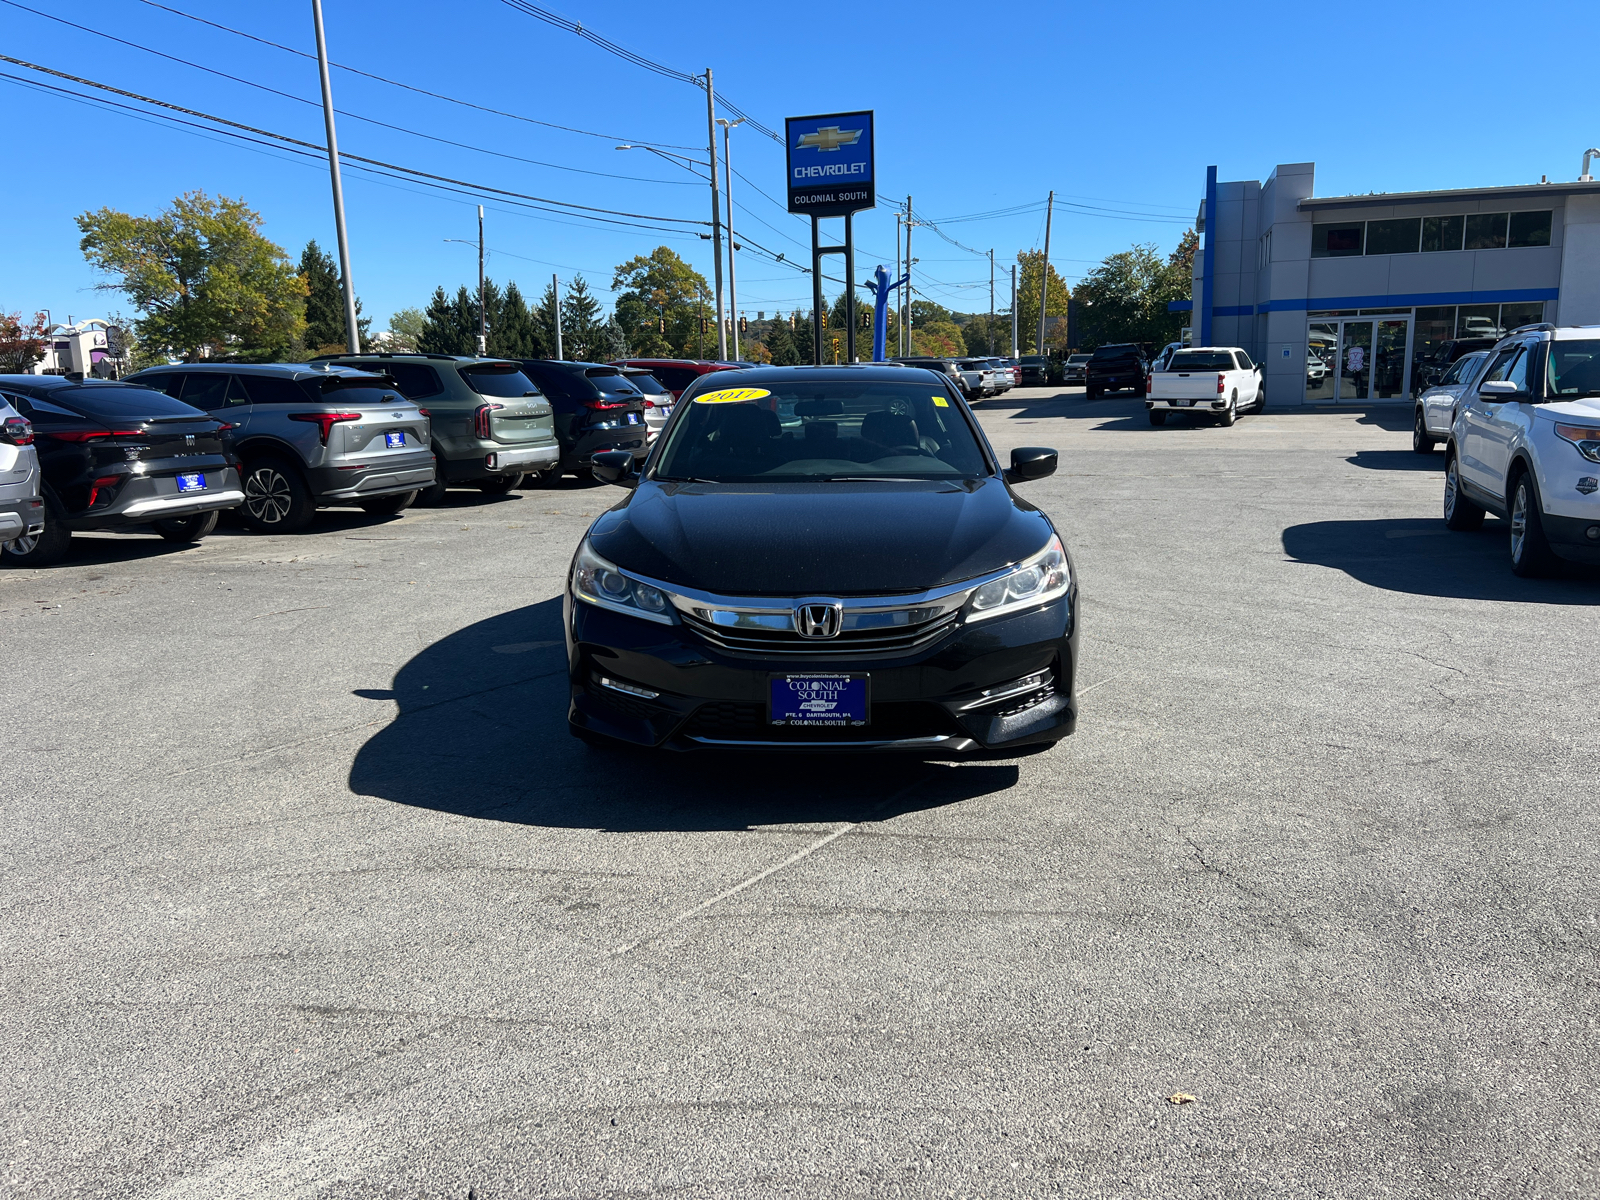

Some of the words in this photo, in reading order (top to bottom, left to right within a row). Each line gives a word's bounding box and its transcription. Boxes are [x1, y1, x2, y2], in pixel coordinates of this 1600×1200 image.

[794, 162, 866, 178] CHEVROLET
[794, 193, 836, 204] COLONIAL
[838, 191, 868, 201] SOUTH
[706, 390, 758, 402] 2017
[789, 681, 847, 691] COLONIAL
[798, 691, 838, 700] SOUTH
